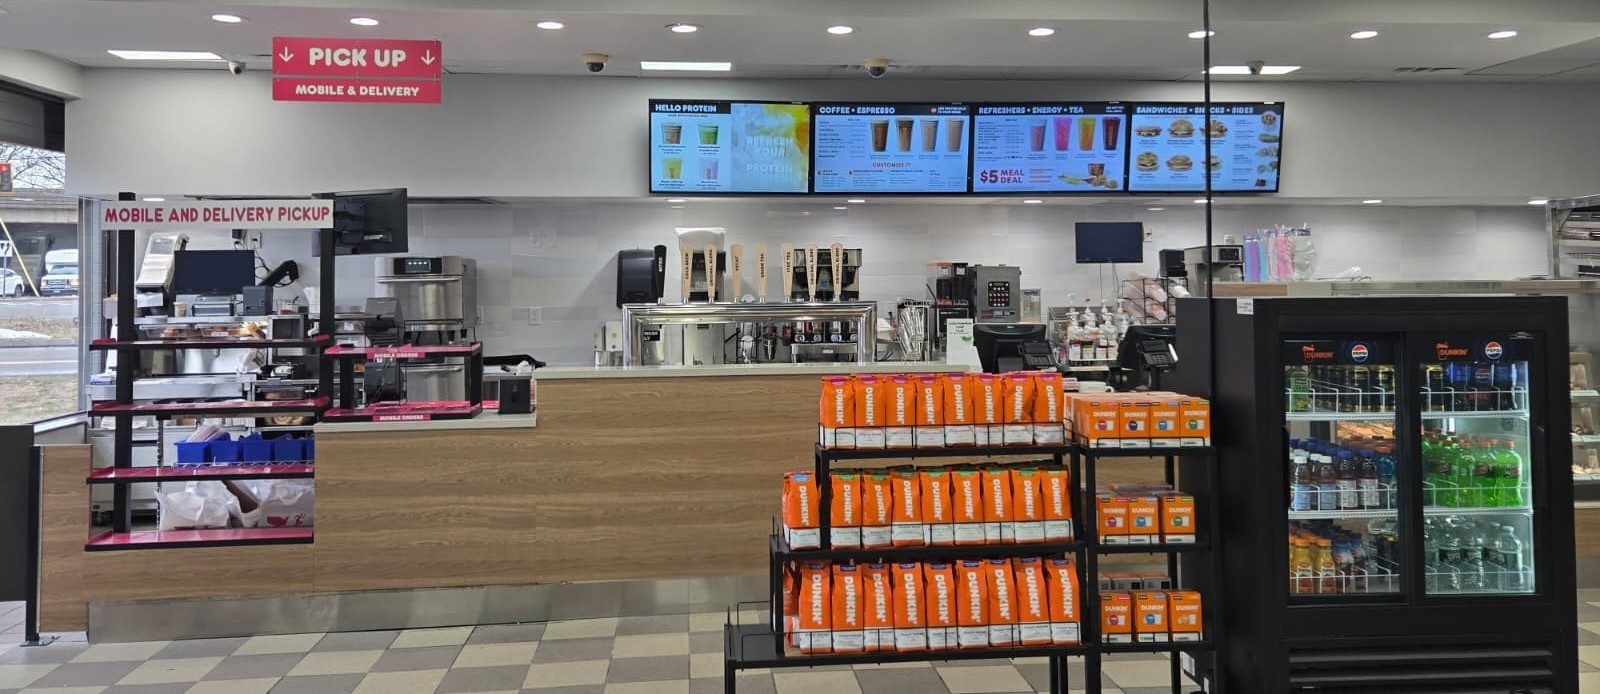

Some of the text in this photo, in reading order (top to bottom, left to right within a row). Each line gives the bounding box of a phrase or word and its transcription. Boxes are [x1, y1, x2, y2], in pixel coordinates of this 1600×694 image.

[308, 47, 407, 68] PICK UP
[295, 84, 420, 97] MOBILE & DELIVERY
[655, 104, 681, 112] HELLO
[819, 106, 896, 114] COFFEE ESPRESSO
[978, 106, 1084, 114] REFRESHERS ENERGY TEA
[1136, 106, 1254, 114] SANDWICHES SNCKS SIDES
[980, 169, 999, 184] $5
[104, 206, 330, 223] MOBILE AND DELIVERY PICKUP
